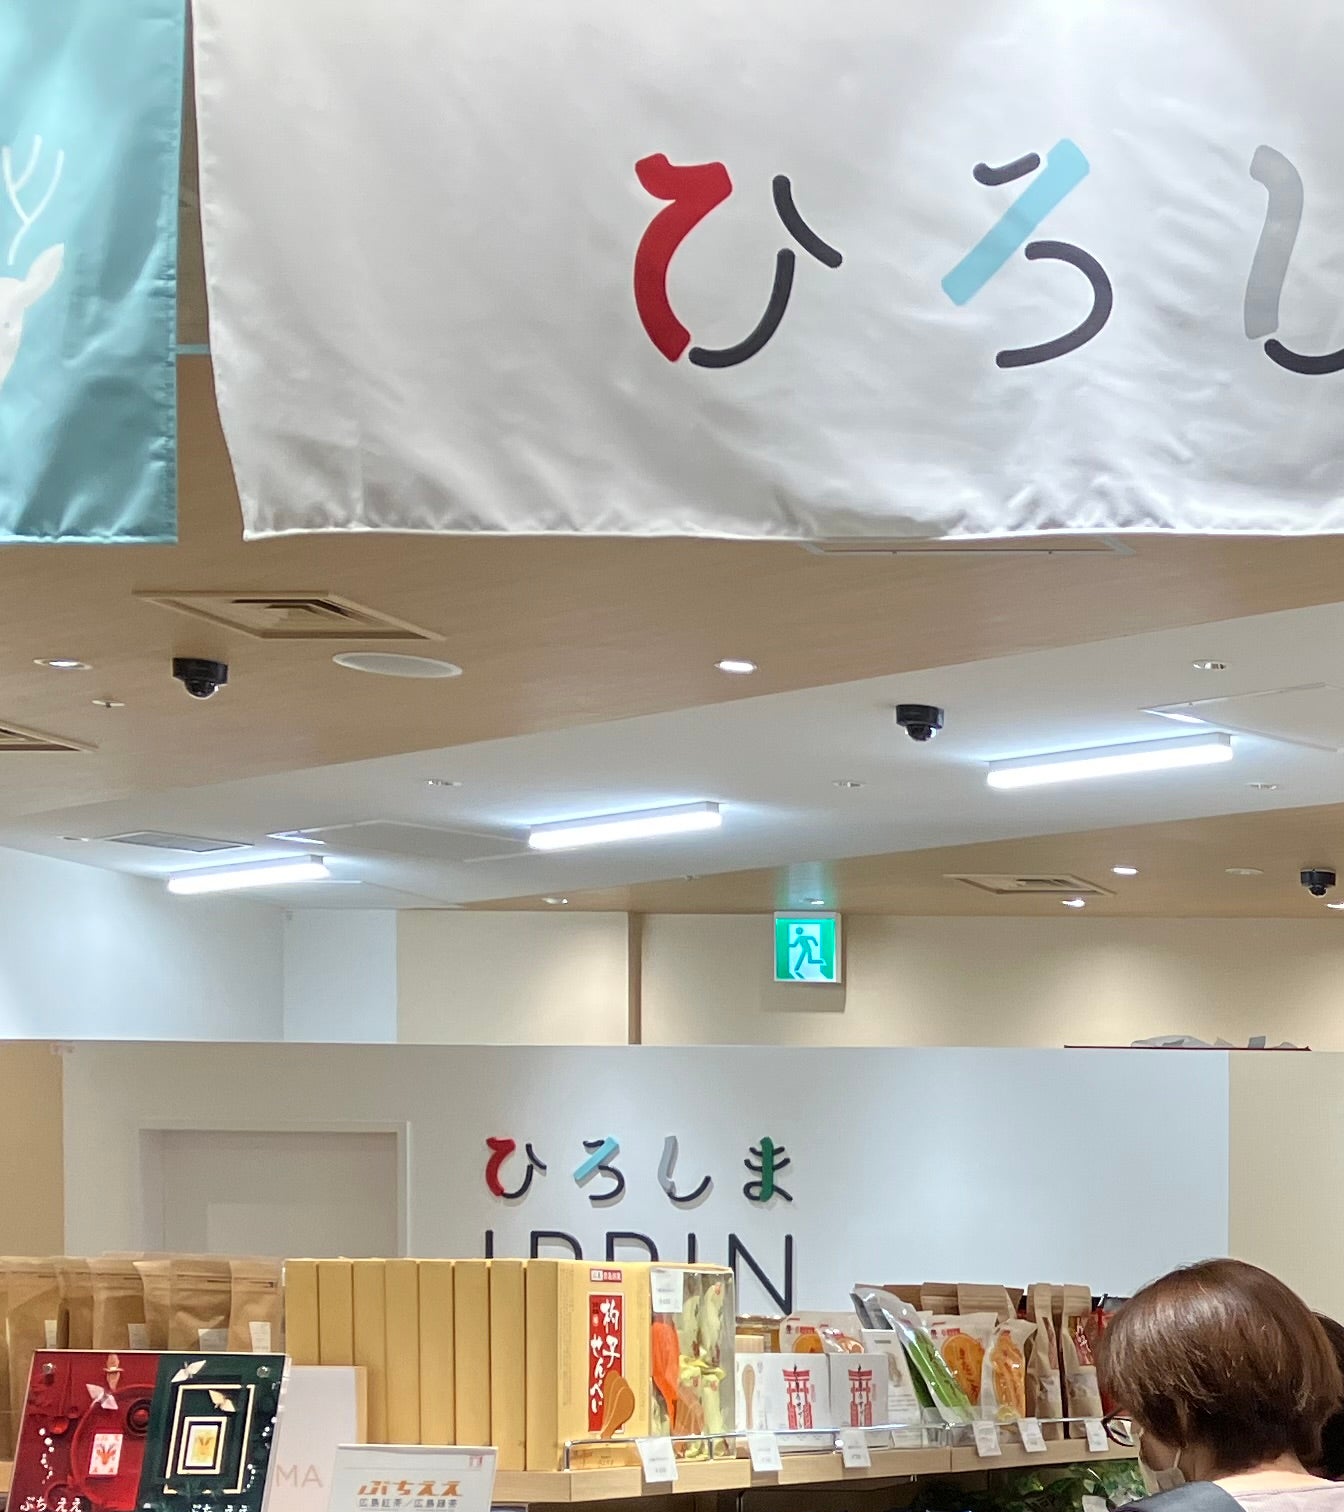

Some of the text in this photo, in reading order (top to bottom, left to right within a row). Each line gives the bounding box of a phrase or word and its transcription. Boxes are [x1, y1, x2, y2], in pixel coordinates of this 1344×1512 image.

[485, 1136, 793, 1202] ひろしま
[590, 1334, 605, 1413] せんべい
[19, 1497, 82, 1512] ぶち ええ
[357, 1480, 464, 1497] ぶちええ
